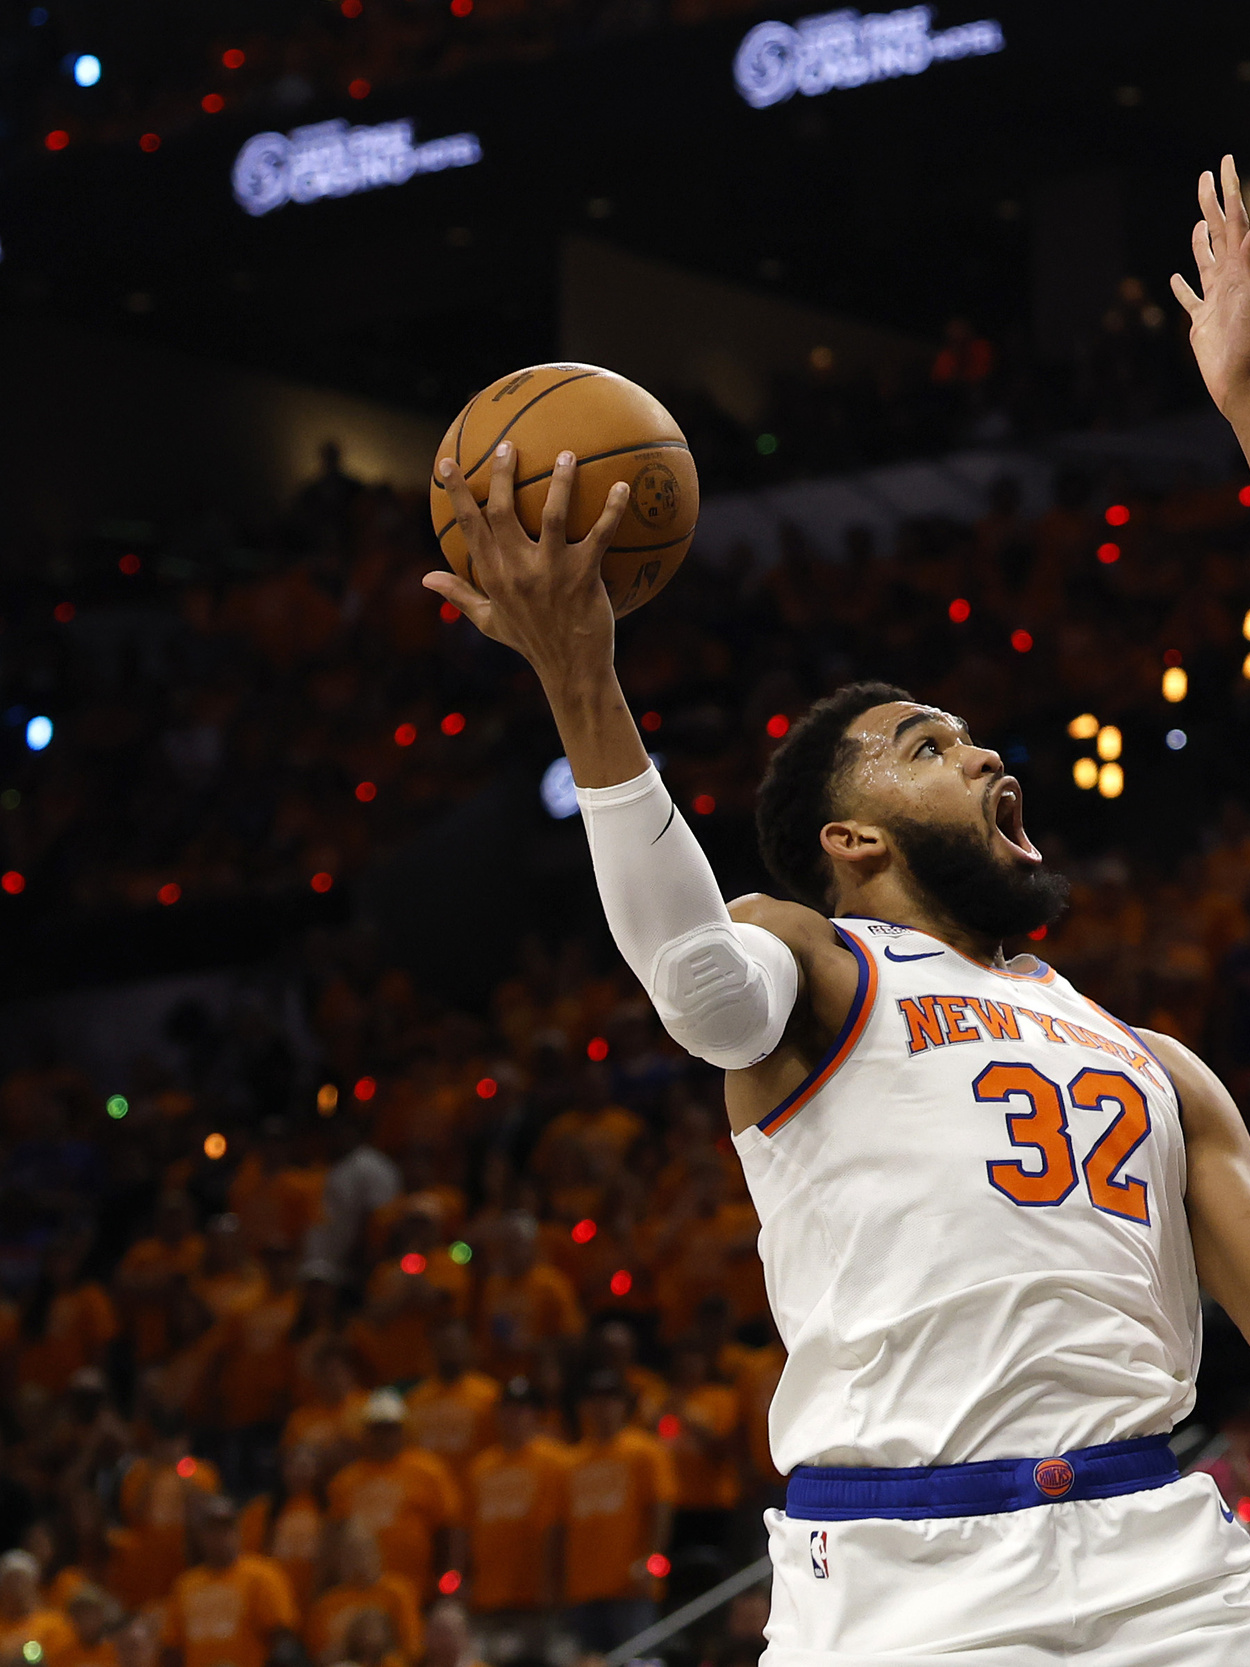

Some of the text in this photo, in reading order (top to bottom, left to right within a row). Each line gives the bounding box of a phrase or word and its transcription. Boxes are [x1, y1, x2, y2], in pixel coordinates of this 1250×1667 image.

[896, 994, 1167, 1093] NEW YORK
[971, 1060, 1151, 1227] 32
